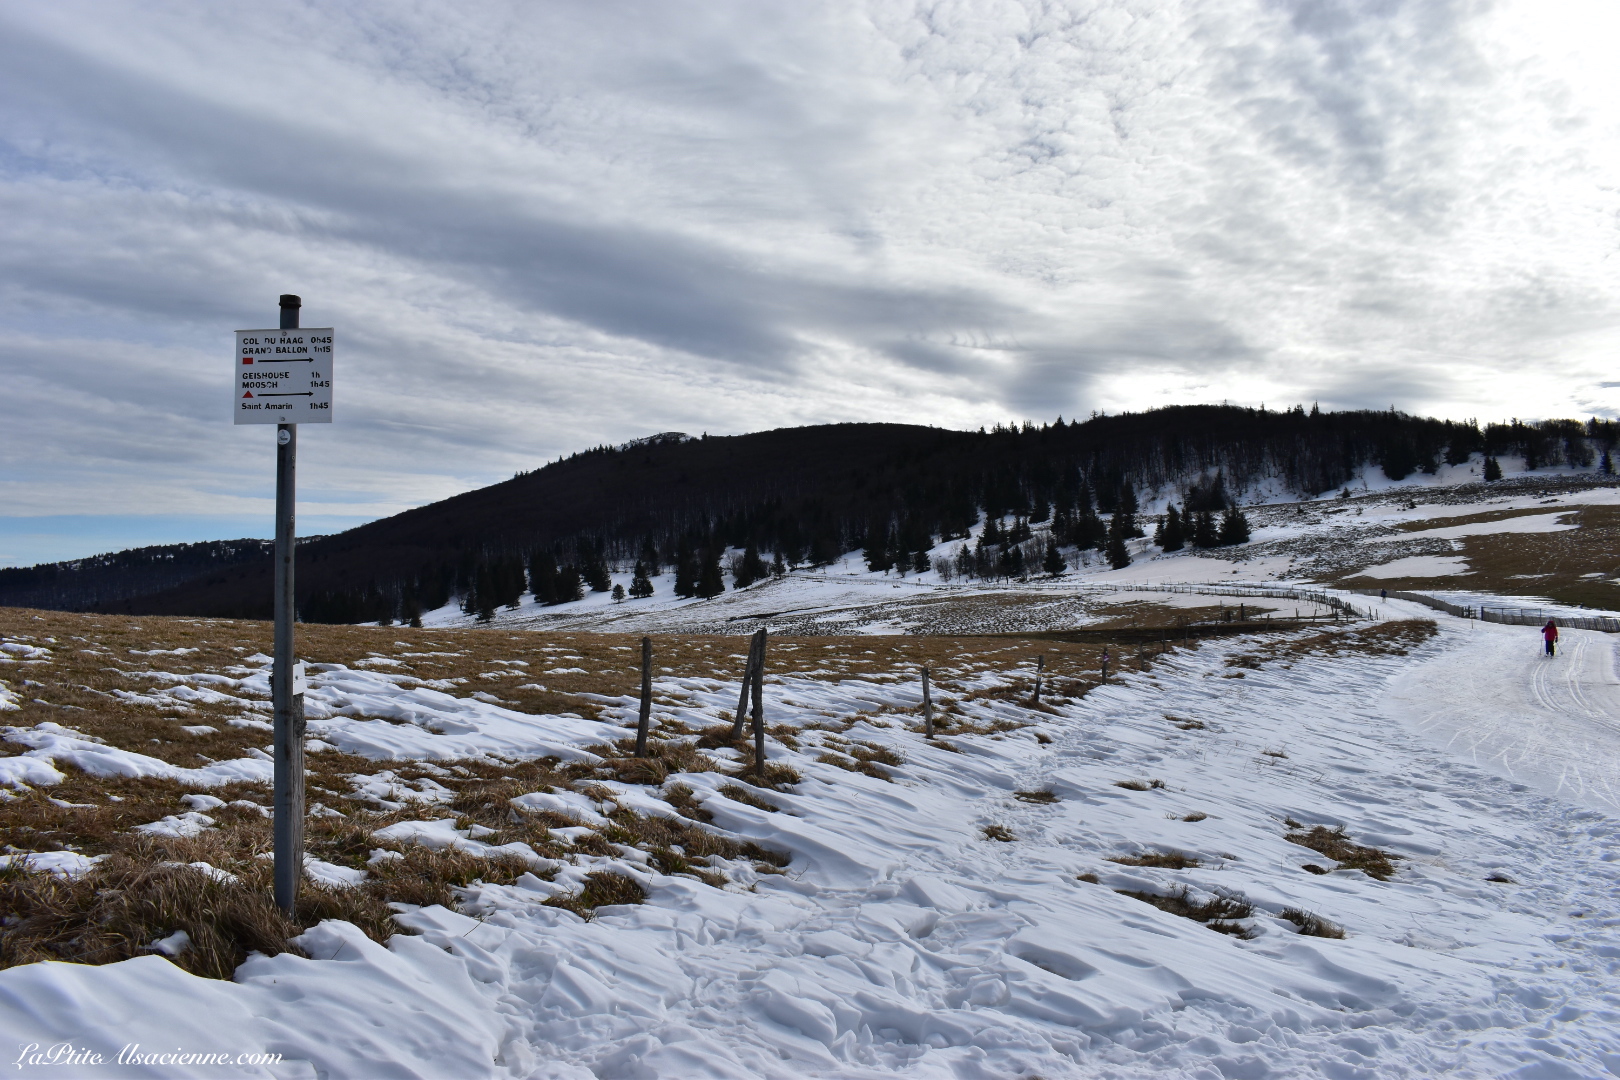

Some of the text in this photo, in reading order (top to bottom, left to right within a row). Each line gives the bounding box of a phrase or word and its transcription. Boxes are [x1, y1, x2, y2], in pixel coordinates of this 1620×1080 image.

[242, 337, 259, 345] COL
[311, 336, 332, 344] 0h45
[275, 346, 308, 354] BALLON
[242, 371, 290, 379] GEISHOUSE
[242, 380, 330, 389] MOOSCH 1h45
[241, 402, 329, 410] Saint Amarin 1h45
